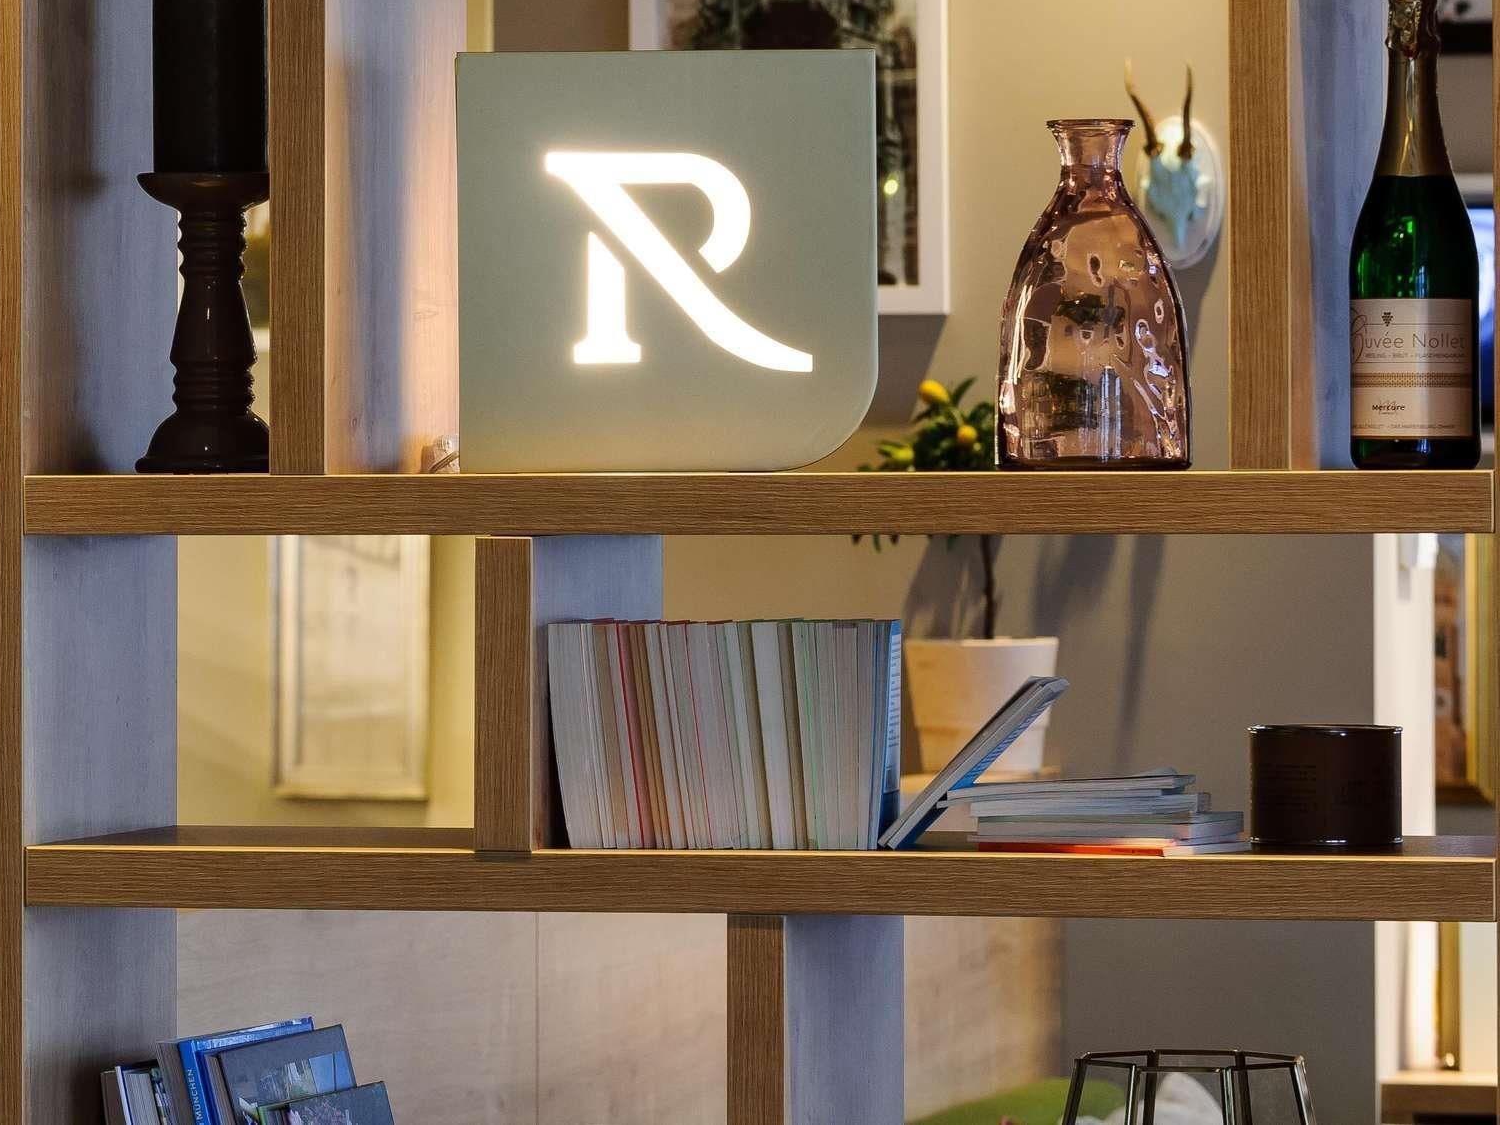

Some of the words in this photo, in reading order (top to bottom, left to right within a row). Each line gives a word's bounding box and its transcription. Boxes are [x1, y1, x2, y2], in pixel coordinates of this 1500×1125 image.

[545, 151, 813, 373] R
[1412, 333, 1465, 349] Nollet
[1372, 403, 1405, 412] Mercure
